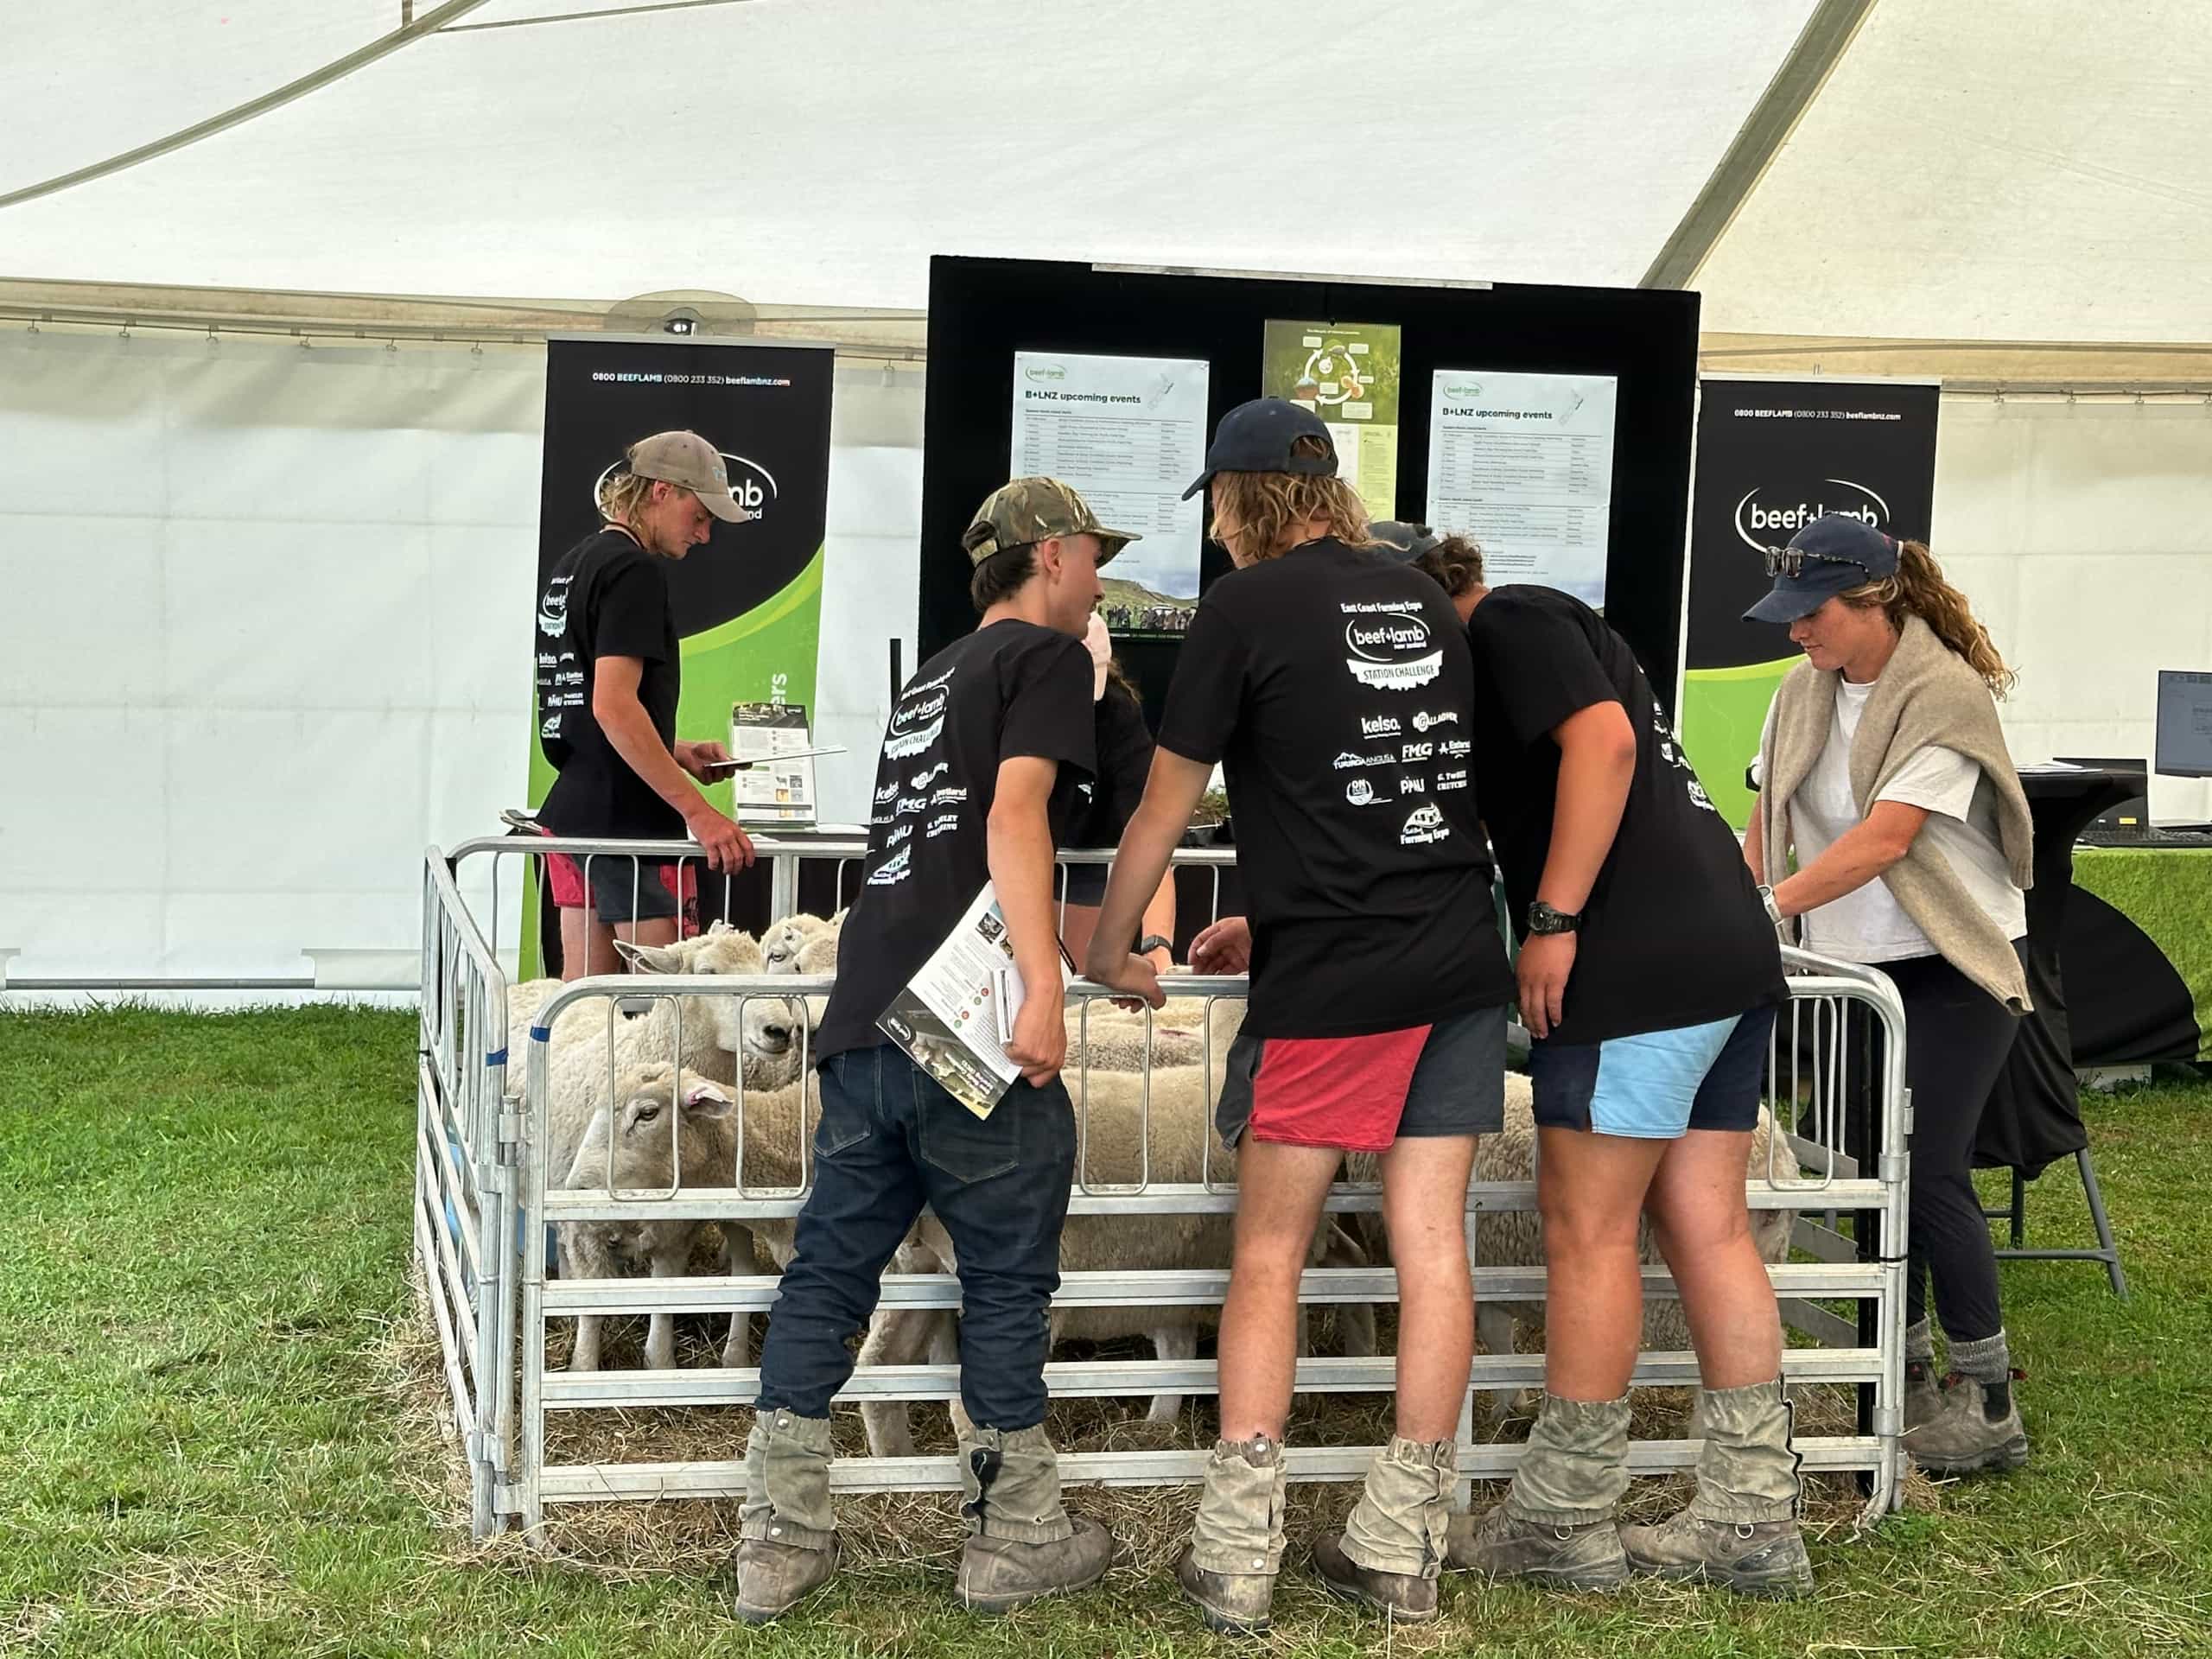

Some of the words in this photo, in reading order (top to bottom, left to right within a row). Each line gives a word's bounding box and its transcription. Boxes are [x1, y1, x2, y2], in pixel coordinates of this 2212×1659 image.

[593, 372, 615, 382] 0800
[617, 373, 663, 383] BEEFLAMB
[664, 374, 690, 385] (0800
[725, 376, 791, 386] beeflambnz.com
[1025, 391, 1058, 400] B+LNZ
[1060, 393, 1108, 404] upcoming
[1109, 395, 1141, 404] events
[1442, 407, 1474, 416] B+LNZ
[1476, 410, 1521, 421] upcoming
[1522, 411, 1553, 420] events
[1734, 409, 1754, 417] 0800
[1755, 410, 1794, 418] BEEFLAMB
[1751, 503, 1879, 530] beef+lb
[1353, 625, 1425, 646] beef+lamb
[1363, 668, 1395, 681] STATION
[1395, 664, 1434, 678] CHALLENGE
[1402, 742, 1433, 759] FMG
